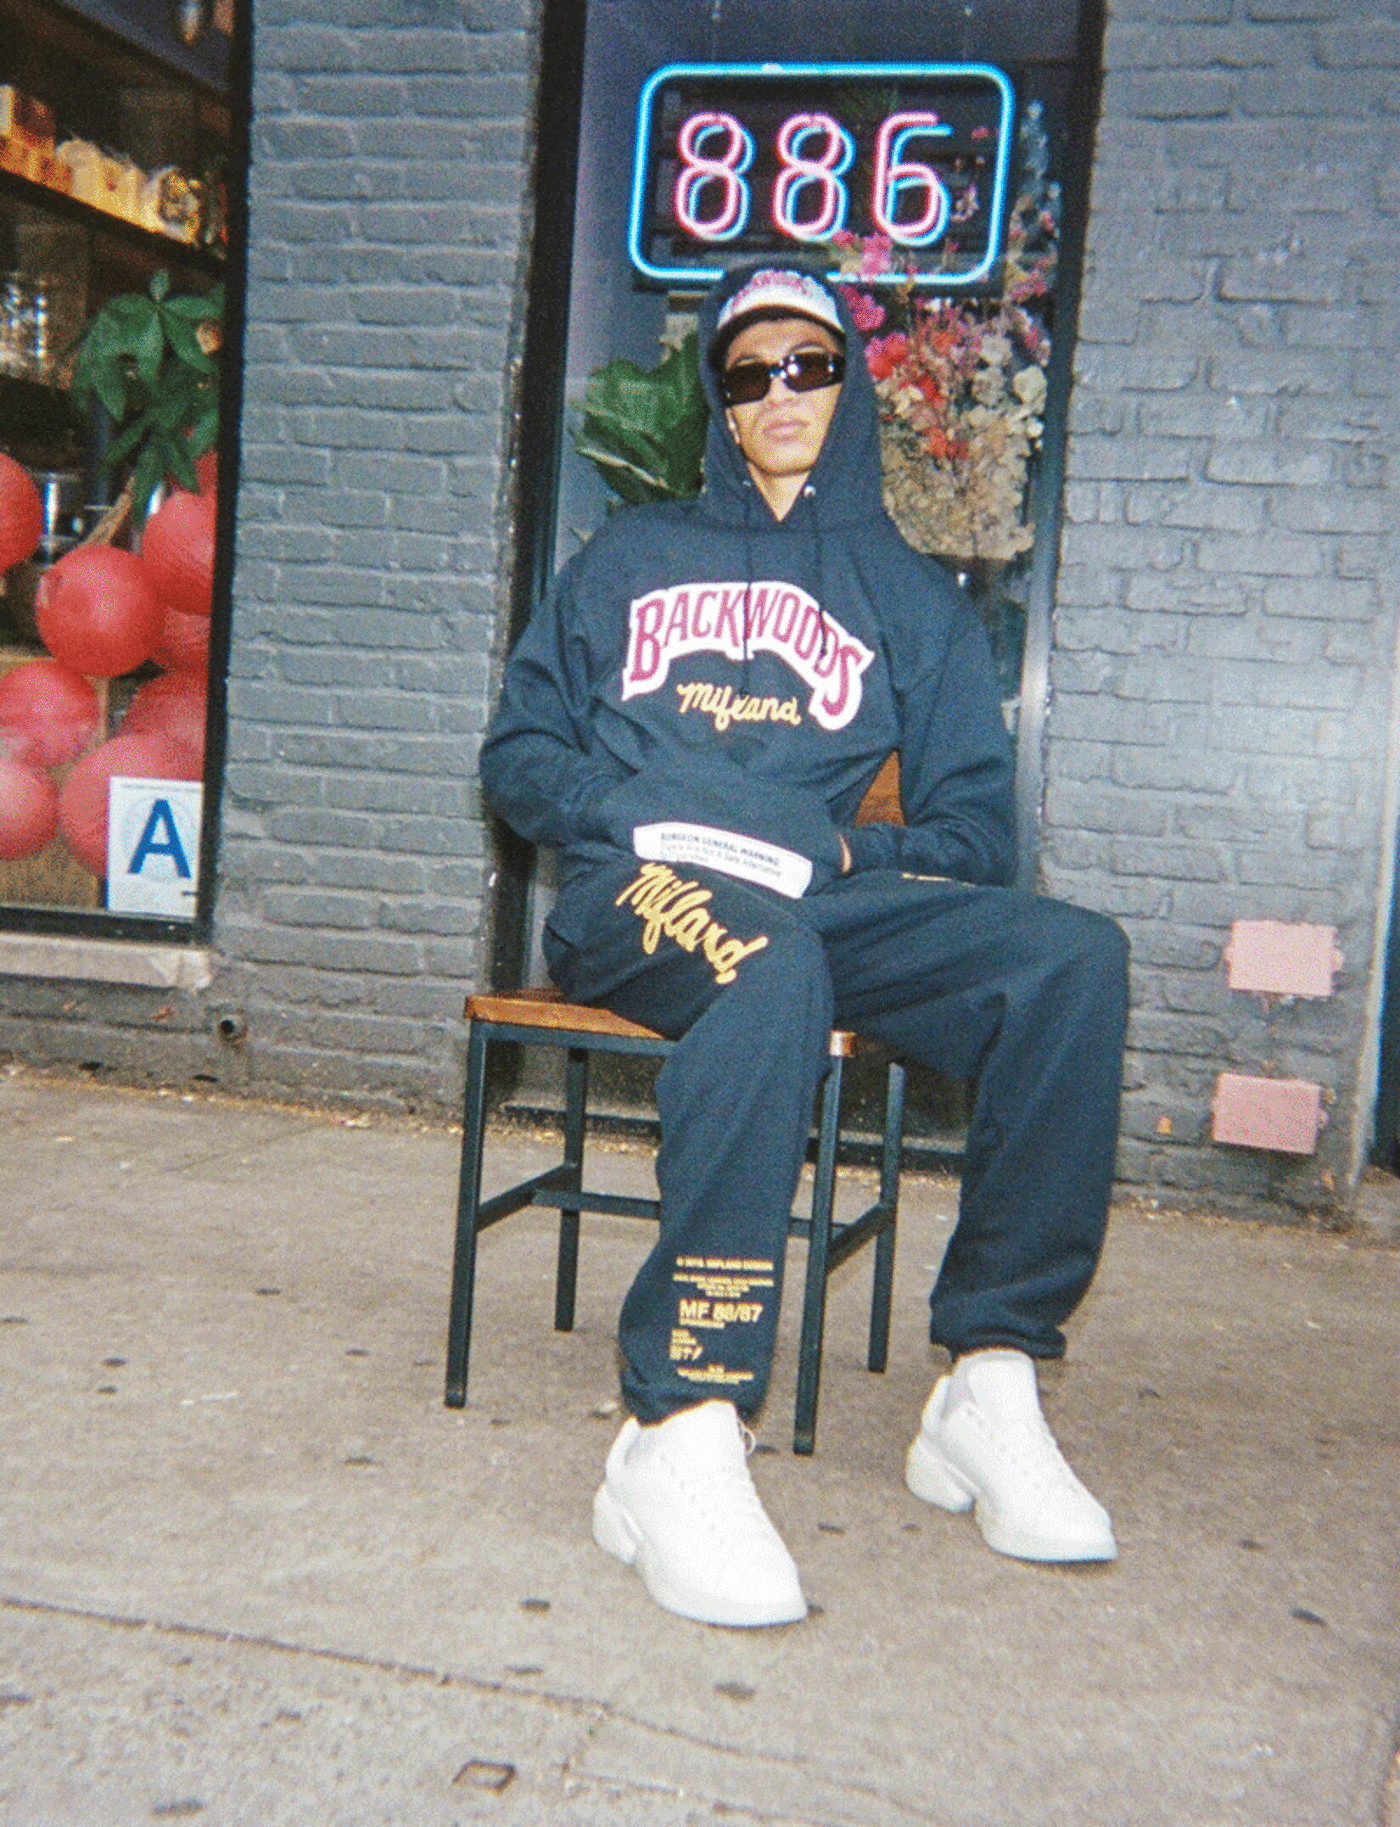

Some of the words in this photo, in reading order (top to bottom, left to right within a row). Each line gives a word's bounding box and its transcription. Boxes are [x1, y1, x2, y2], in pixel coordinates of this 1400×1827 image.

[675, 111, 952, 246] 886
[625, 583, 870, 726] BACKWOODS
[127, 798, 192, 879] A
